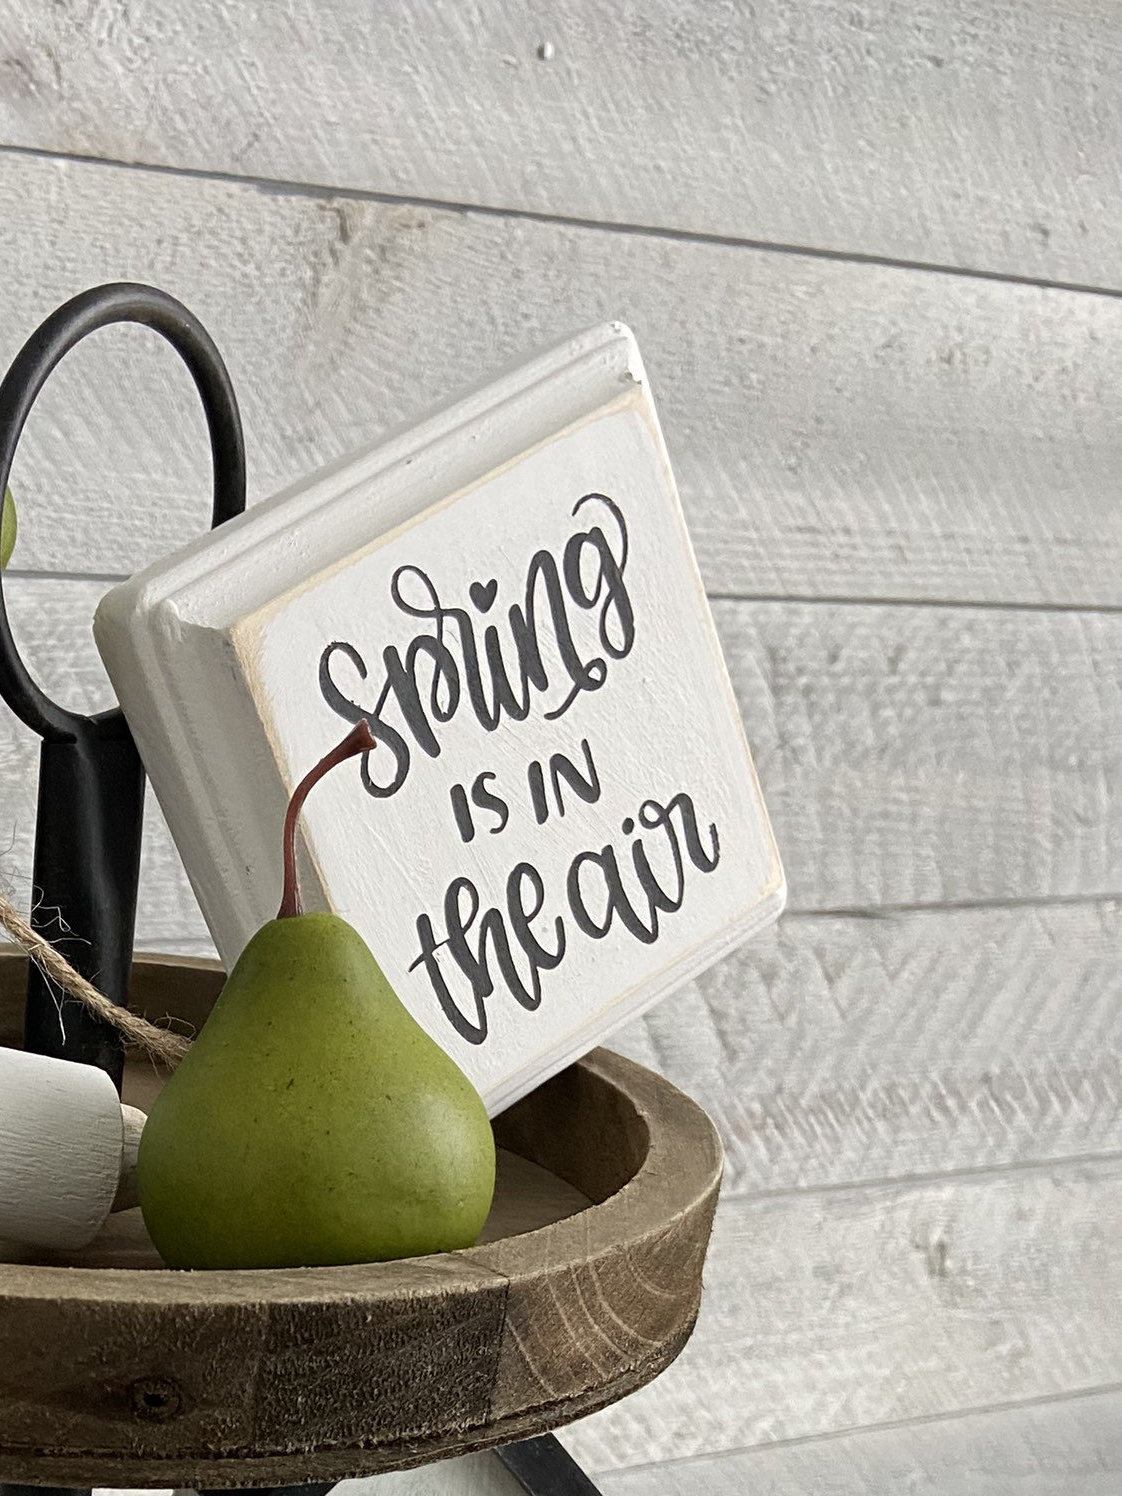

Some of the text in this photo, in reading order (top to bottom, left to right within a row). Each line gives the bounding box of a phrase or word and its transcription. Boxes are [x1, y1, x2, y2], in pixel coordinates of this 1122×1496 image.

[450, 738, 601, 843] IS IN
[408, 792, 720, 1045] the air
